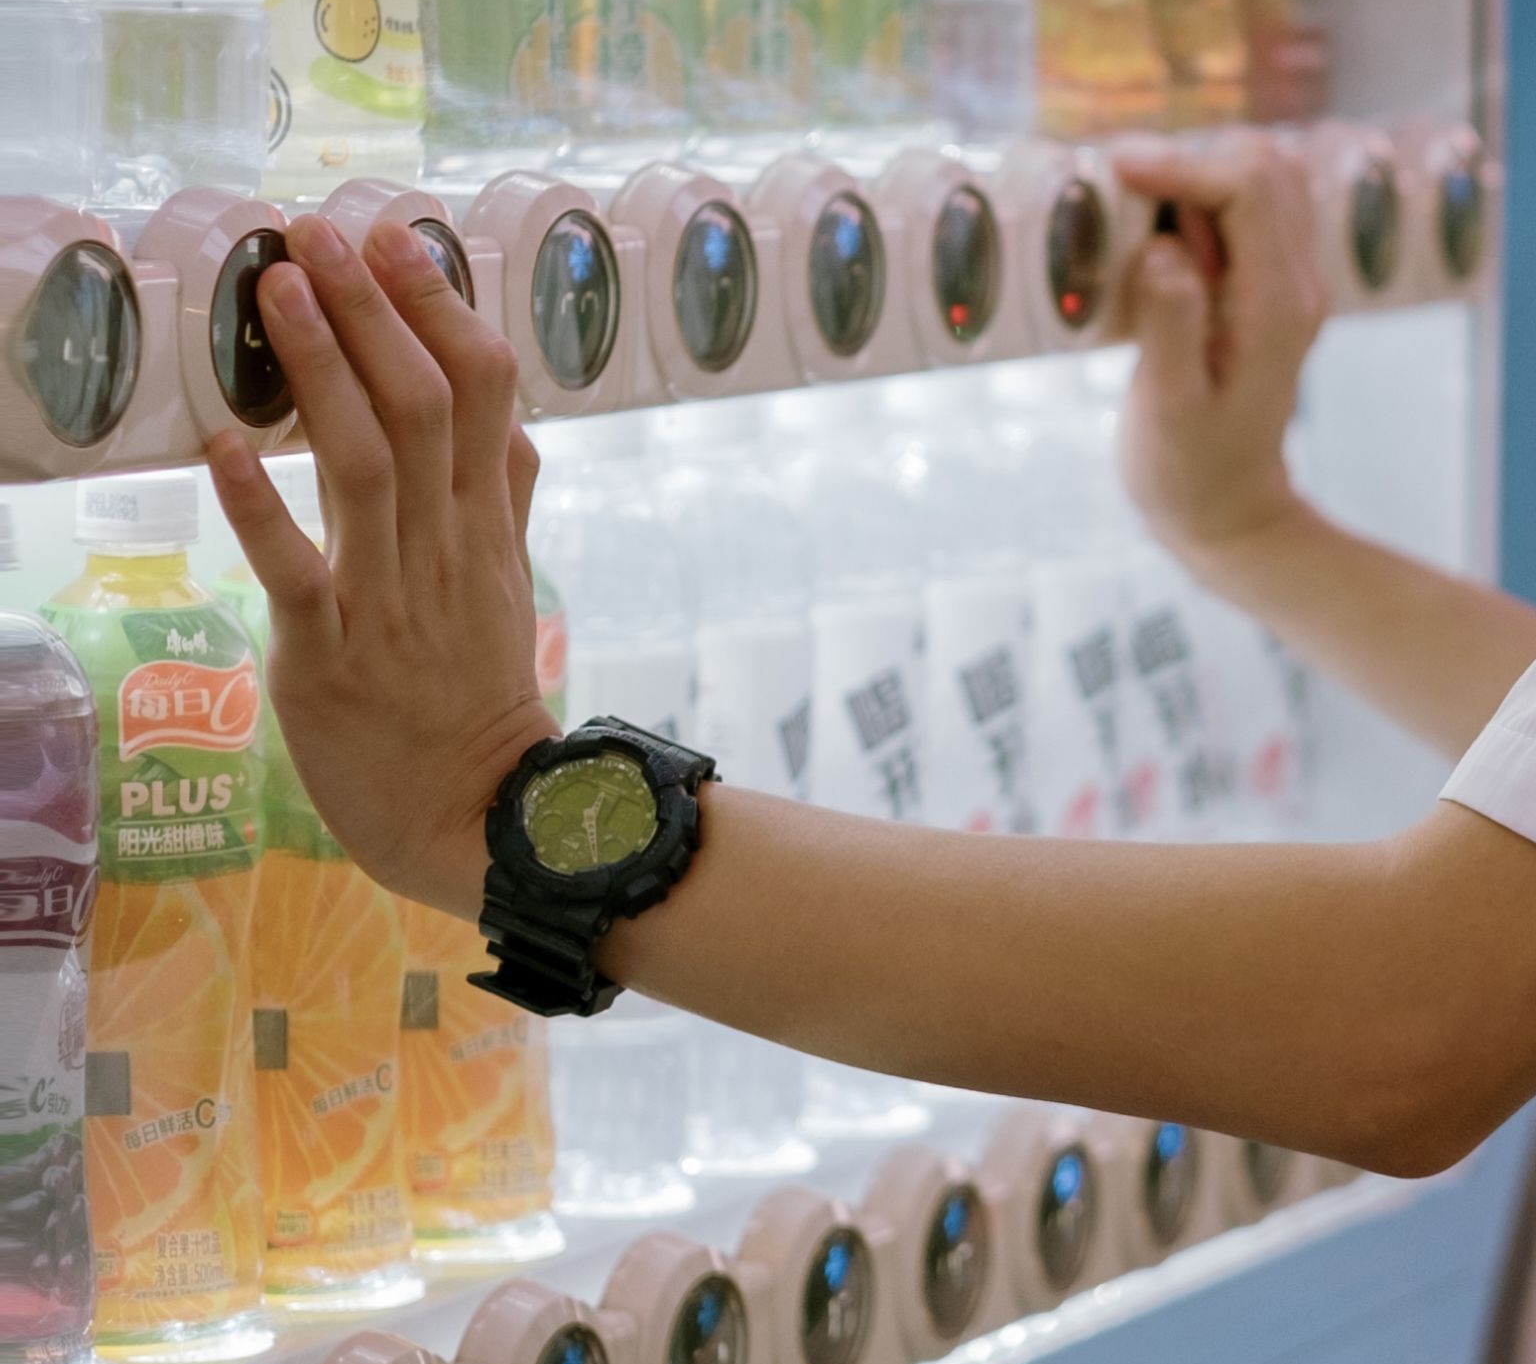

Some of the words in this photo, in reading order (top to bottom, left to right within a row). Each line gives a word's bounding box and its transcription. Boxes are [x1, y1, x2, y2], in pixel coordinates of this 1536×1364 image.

[117, 823, 226, 857] 阳光甜橙味
